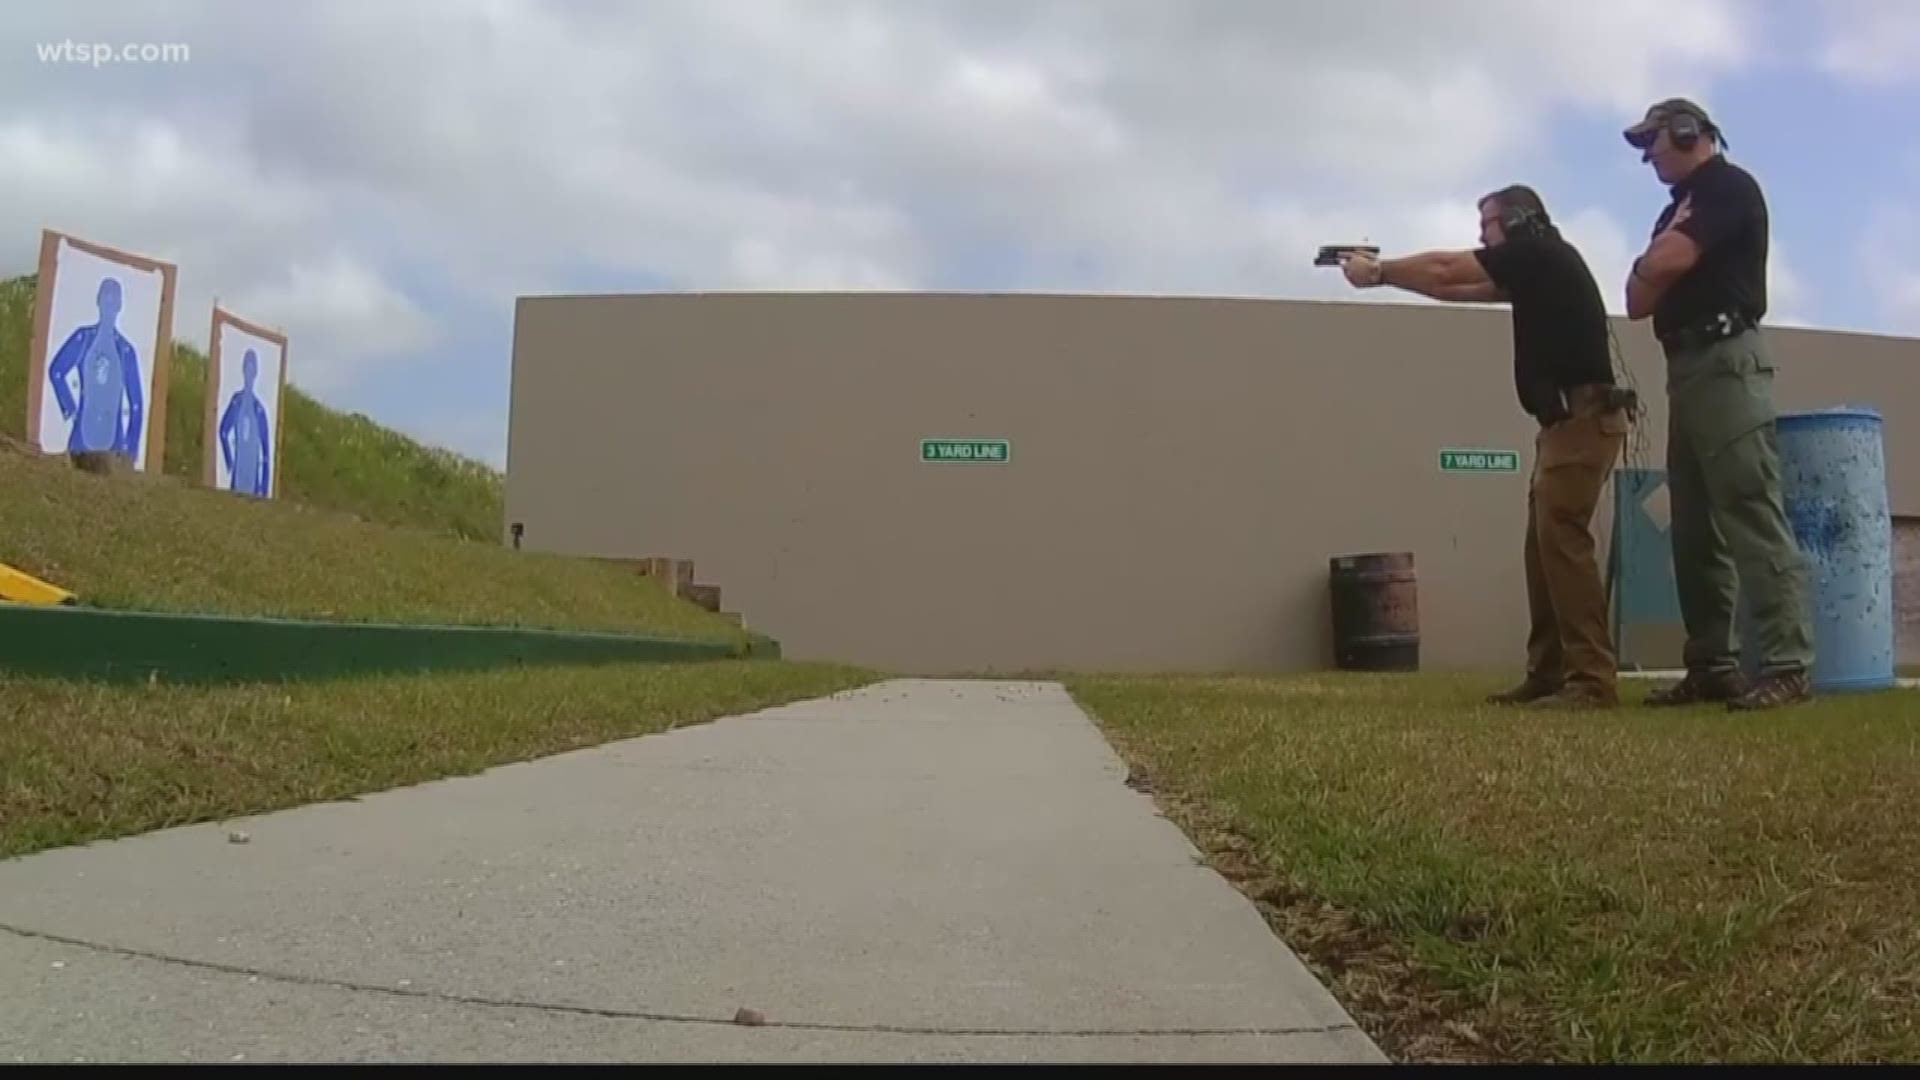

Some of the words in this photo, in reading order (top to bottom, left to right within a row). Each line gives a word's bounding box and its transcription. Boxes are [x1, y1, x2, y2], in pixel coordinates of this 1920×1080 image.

[926, 443, 936, 458] 3
[937, 443, 972, 458] YARD
[974, 443, 1004, 458] LINE
[1444, 454, 1453, 468] 7
[1454, 454, 1486, 469] YARD
[1487, 454, 1513, 469] LINE
